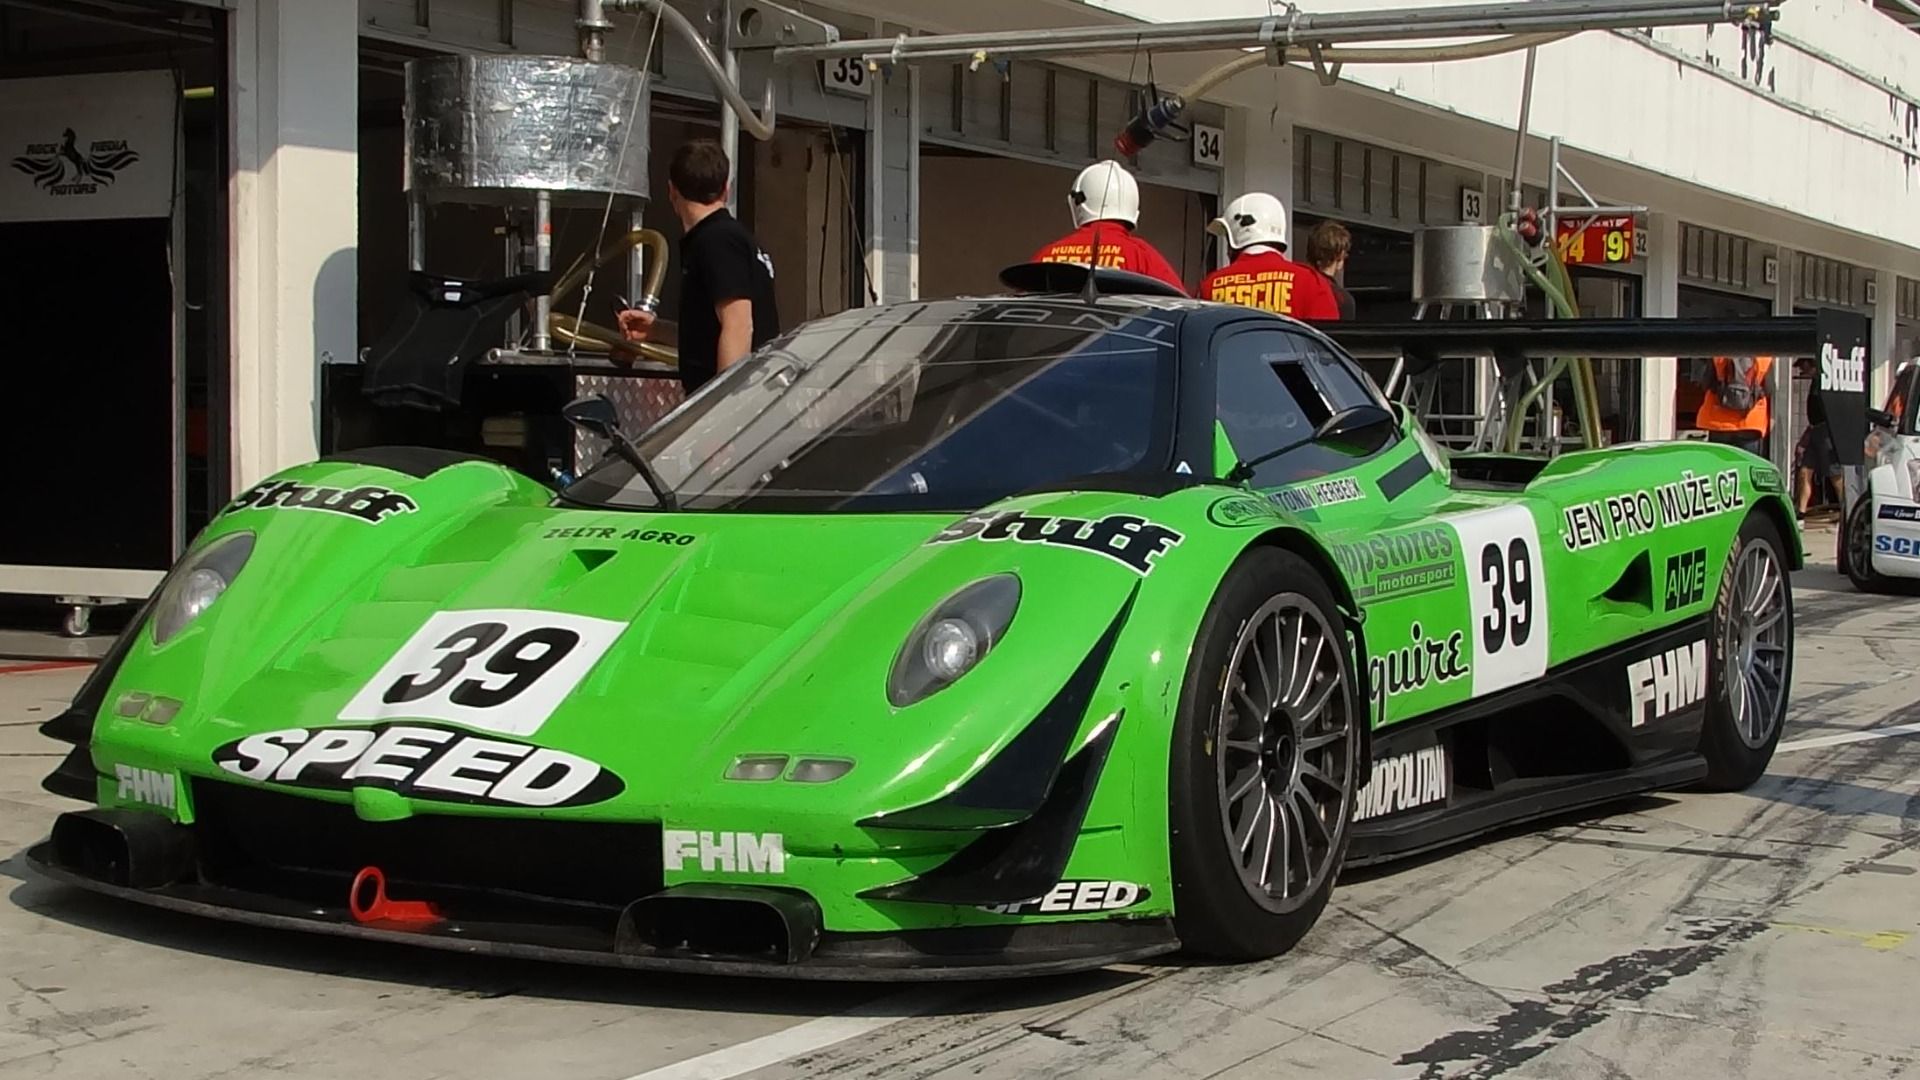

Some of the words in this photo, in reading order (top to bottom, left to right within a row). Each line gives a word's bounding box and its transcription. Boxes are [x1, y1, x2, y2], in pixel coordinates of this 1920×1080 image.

[833, 56, 864, 86] 35
[1199, 131, 1220, 160] 34
[50, 183, 98, 196] MOTORS
[1466, 194, 1480, 218] 33
[1051, 245, 1121, 256] HUNGAIAN
[1212, 273, 1257, 287] OPEL
[1821, 342, 1866, 393] Stuff
[1563, 504, 1609, 550] JEN
[1608, 492, 1656, 537] PRO
[1655, 471, 1743, 524] MUŽE.CZ
[544, 526, 617, 542] ZELTR
[621, 528, 696, 546] AGRO
[925, 511, 1185, 577] Stuff
[1379, 564, 1455, 592] motorsport
[1481, 538, 1533, 654] 39
[1666, 560, 1705, 599] AVE
[381, 621, 580, 708] 39
[1626, 639, 1706, 728] FHM
[115, 763, 175, 809] FHM
[219, 726, 602, 805] SPEED
[663, 830, 785, 874] FHM
